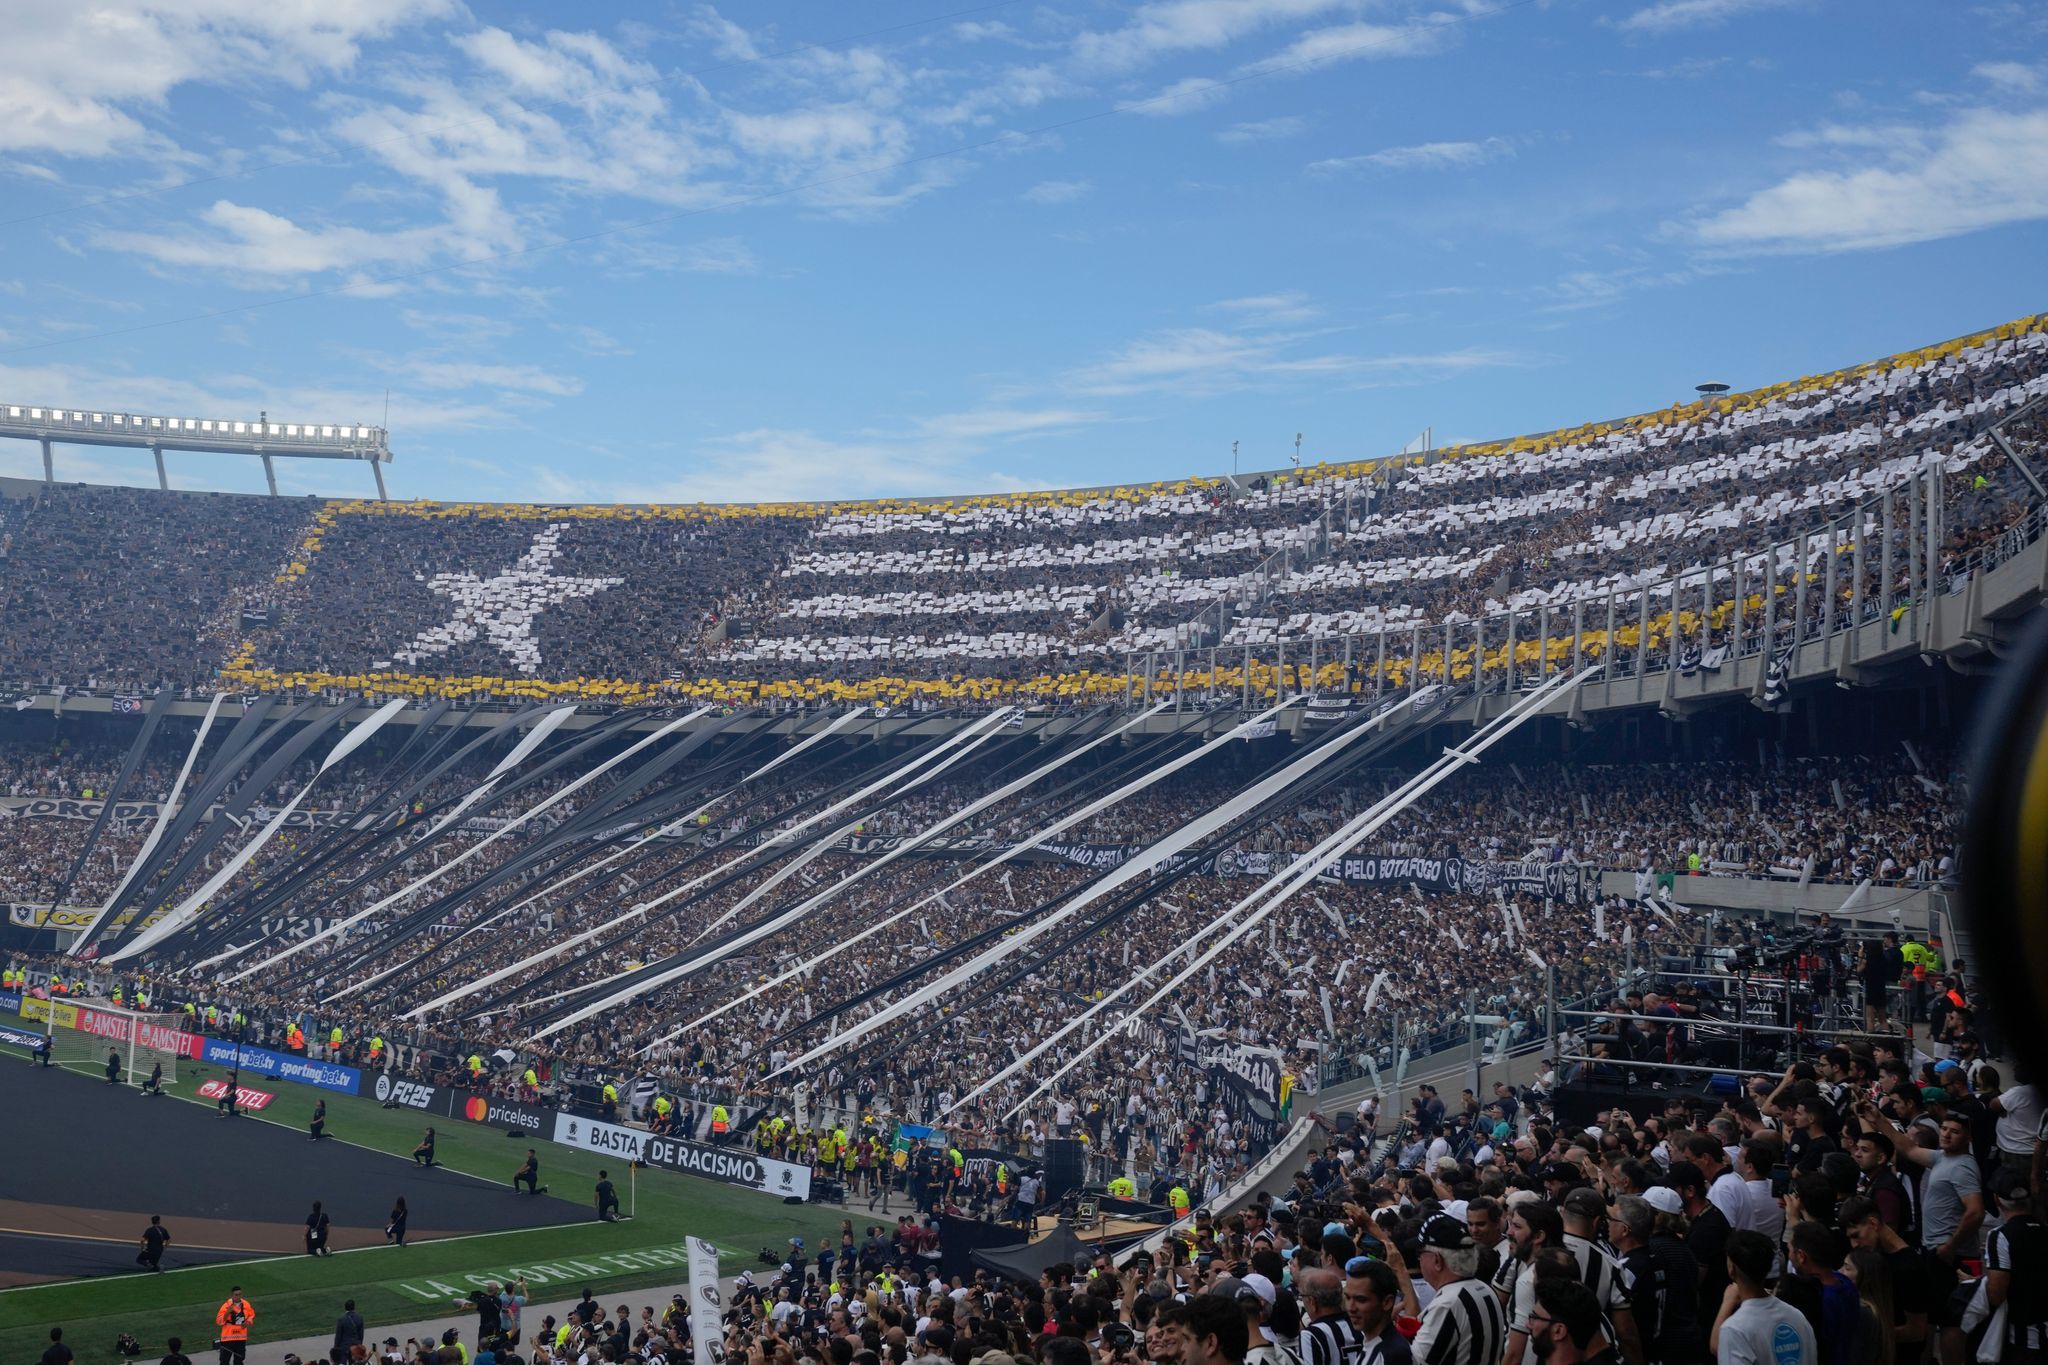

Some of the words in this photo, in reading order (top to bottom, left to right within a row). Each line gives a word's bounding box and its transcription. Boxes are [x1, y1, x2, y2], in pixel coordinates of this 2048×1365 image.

[9, 800, 160, 820] TORCDA
[1344, 859, 1376, 881] PELO
[1379, 857, 1442, 882] BOTAFOGO
[150, 1026, 192, 1056] AMSTEL
[280, 1061, 351, 1087] sportingbet.tv
[488, 1106, 541, 1130] priceless
[590, 1127, 638, 1156] BASTA
[651, 1143, 674, 1164] DE
[677, 1147, 757, 1182] RACISMO
[400, 1280, 467, 1298] LA
[464, 1260, 612, 1288] GLORIA
